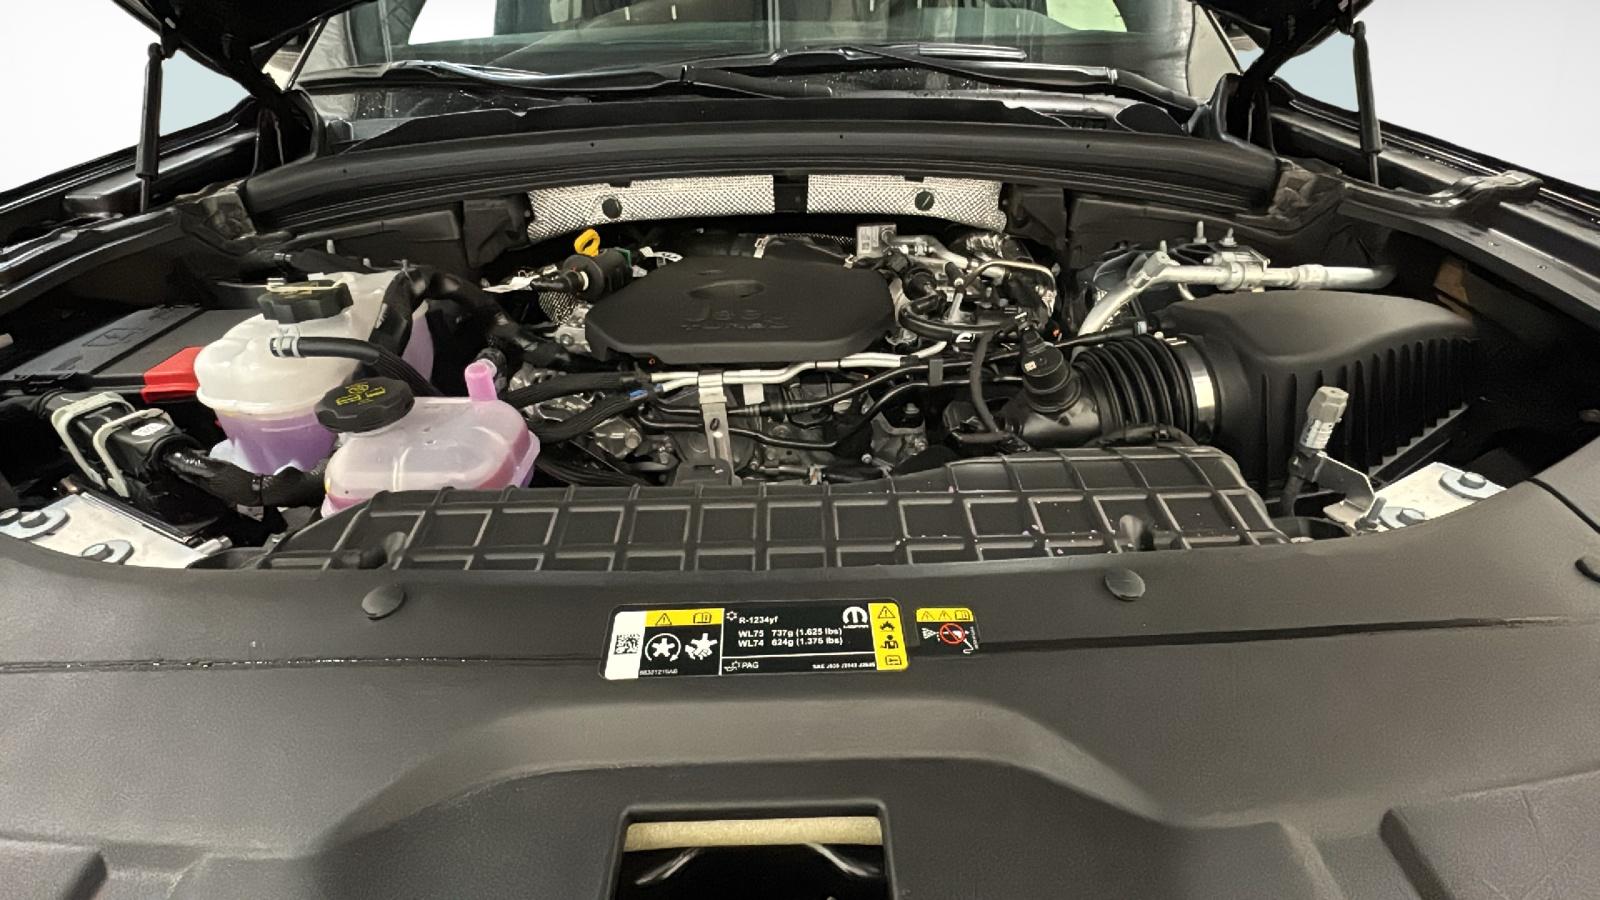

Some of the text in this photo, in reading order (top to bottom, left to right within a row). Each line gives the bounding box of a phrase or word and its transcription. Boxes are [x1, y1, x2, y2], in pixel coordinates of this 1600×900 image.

[739, 616, 778, 624] R-1234yf
[771, 629, 793, 637] 737g
[796, 628, 823, 636] (1.625
[825, 627, 842, 635] lbs)
[771, 639, 793, 647] 624g
[796, 637, 823, 646] (1.375
[826, 637, 843, 645] lbs)
